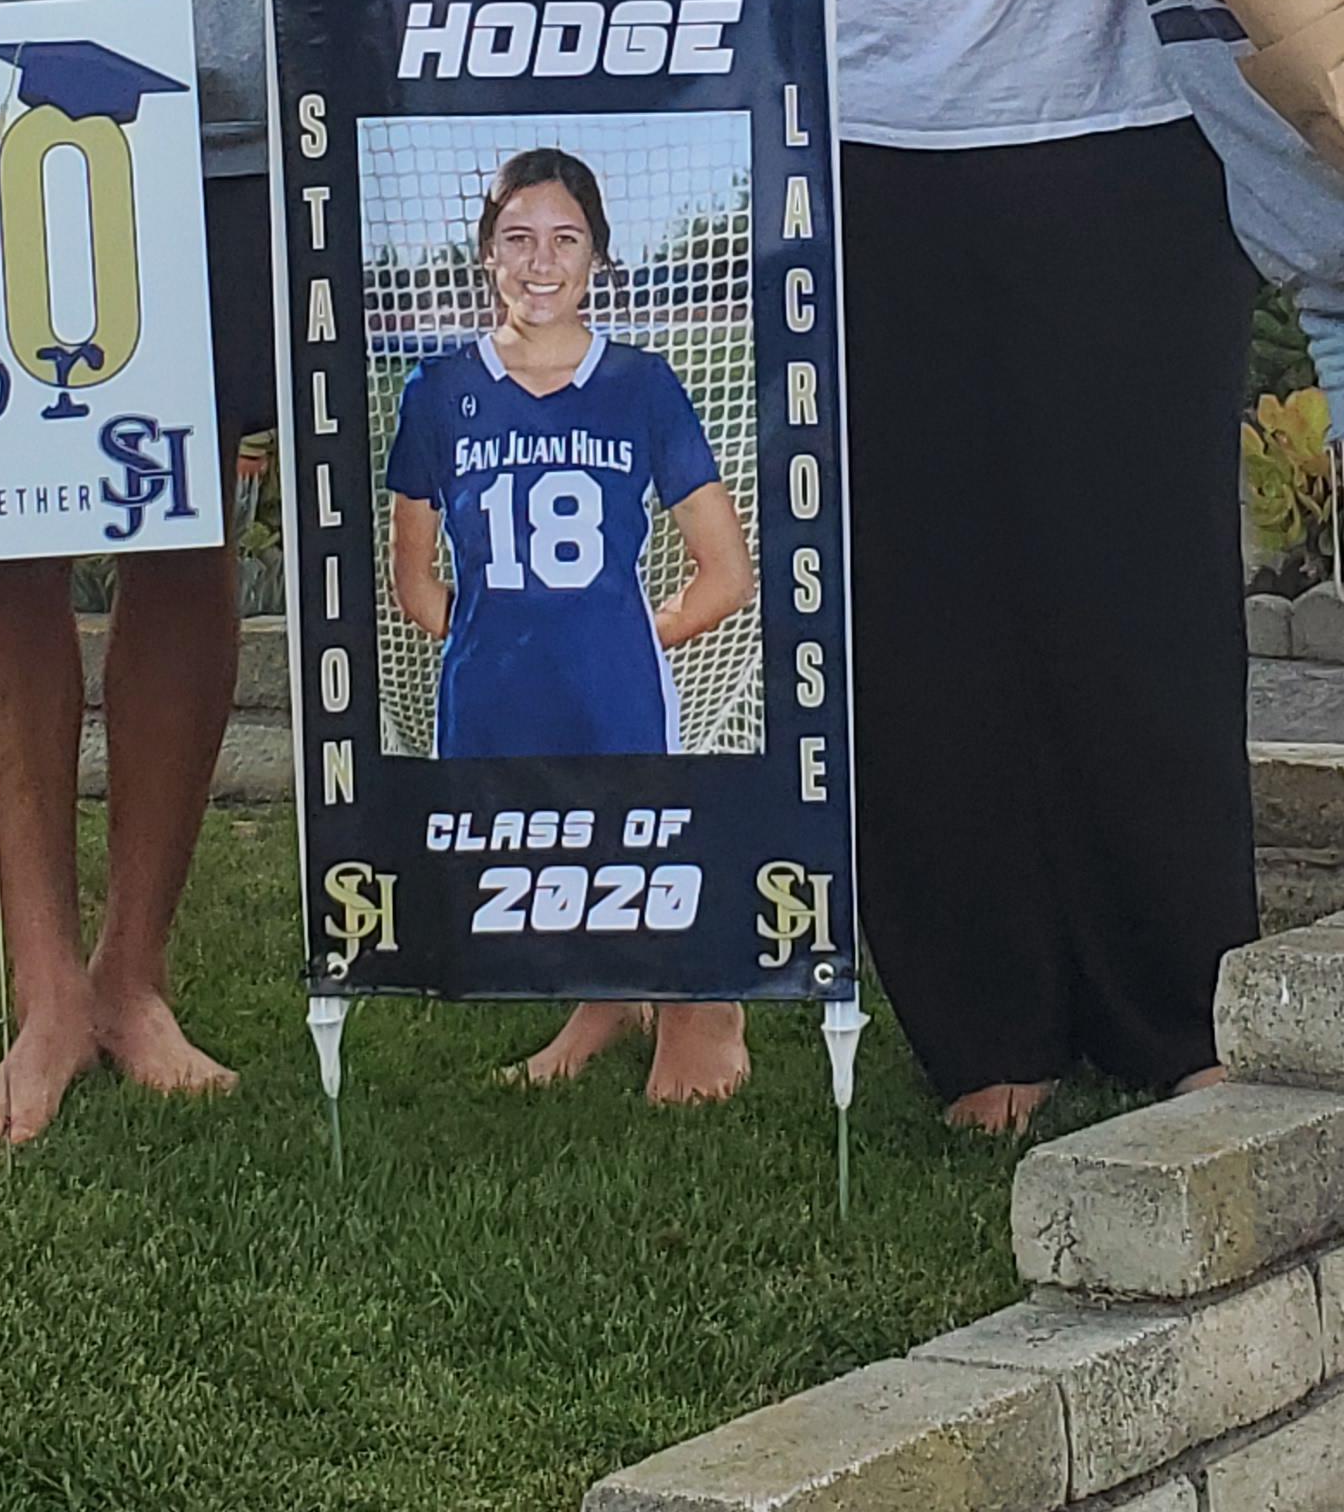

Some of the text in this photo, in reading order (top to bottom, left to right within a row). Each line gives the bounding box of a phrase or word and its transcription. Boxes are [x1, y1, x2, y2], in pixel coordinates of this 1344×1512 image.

[299, 93, 355, 806] STALLION
[783, 84, 829, 802] LACROSSE
[480, 470, 604, 589] 18
[426, 808, 692, 851] CLASS OF
[472, 865, 703, 932] 2020
